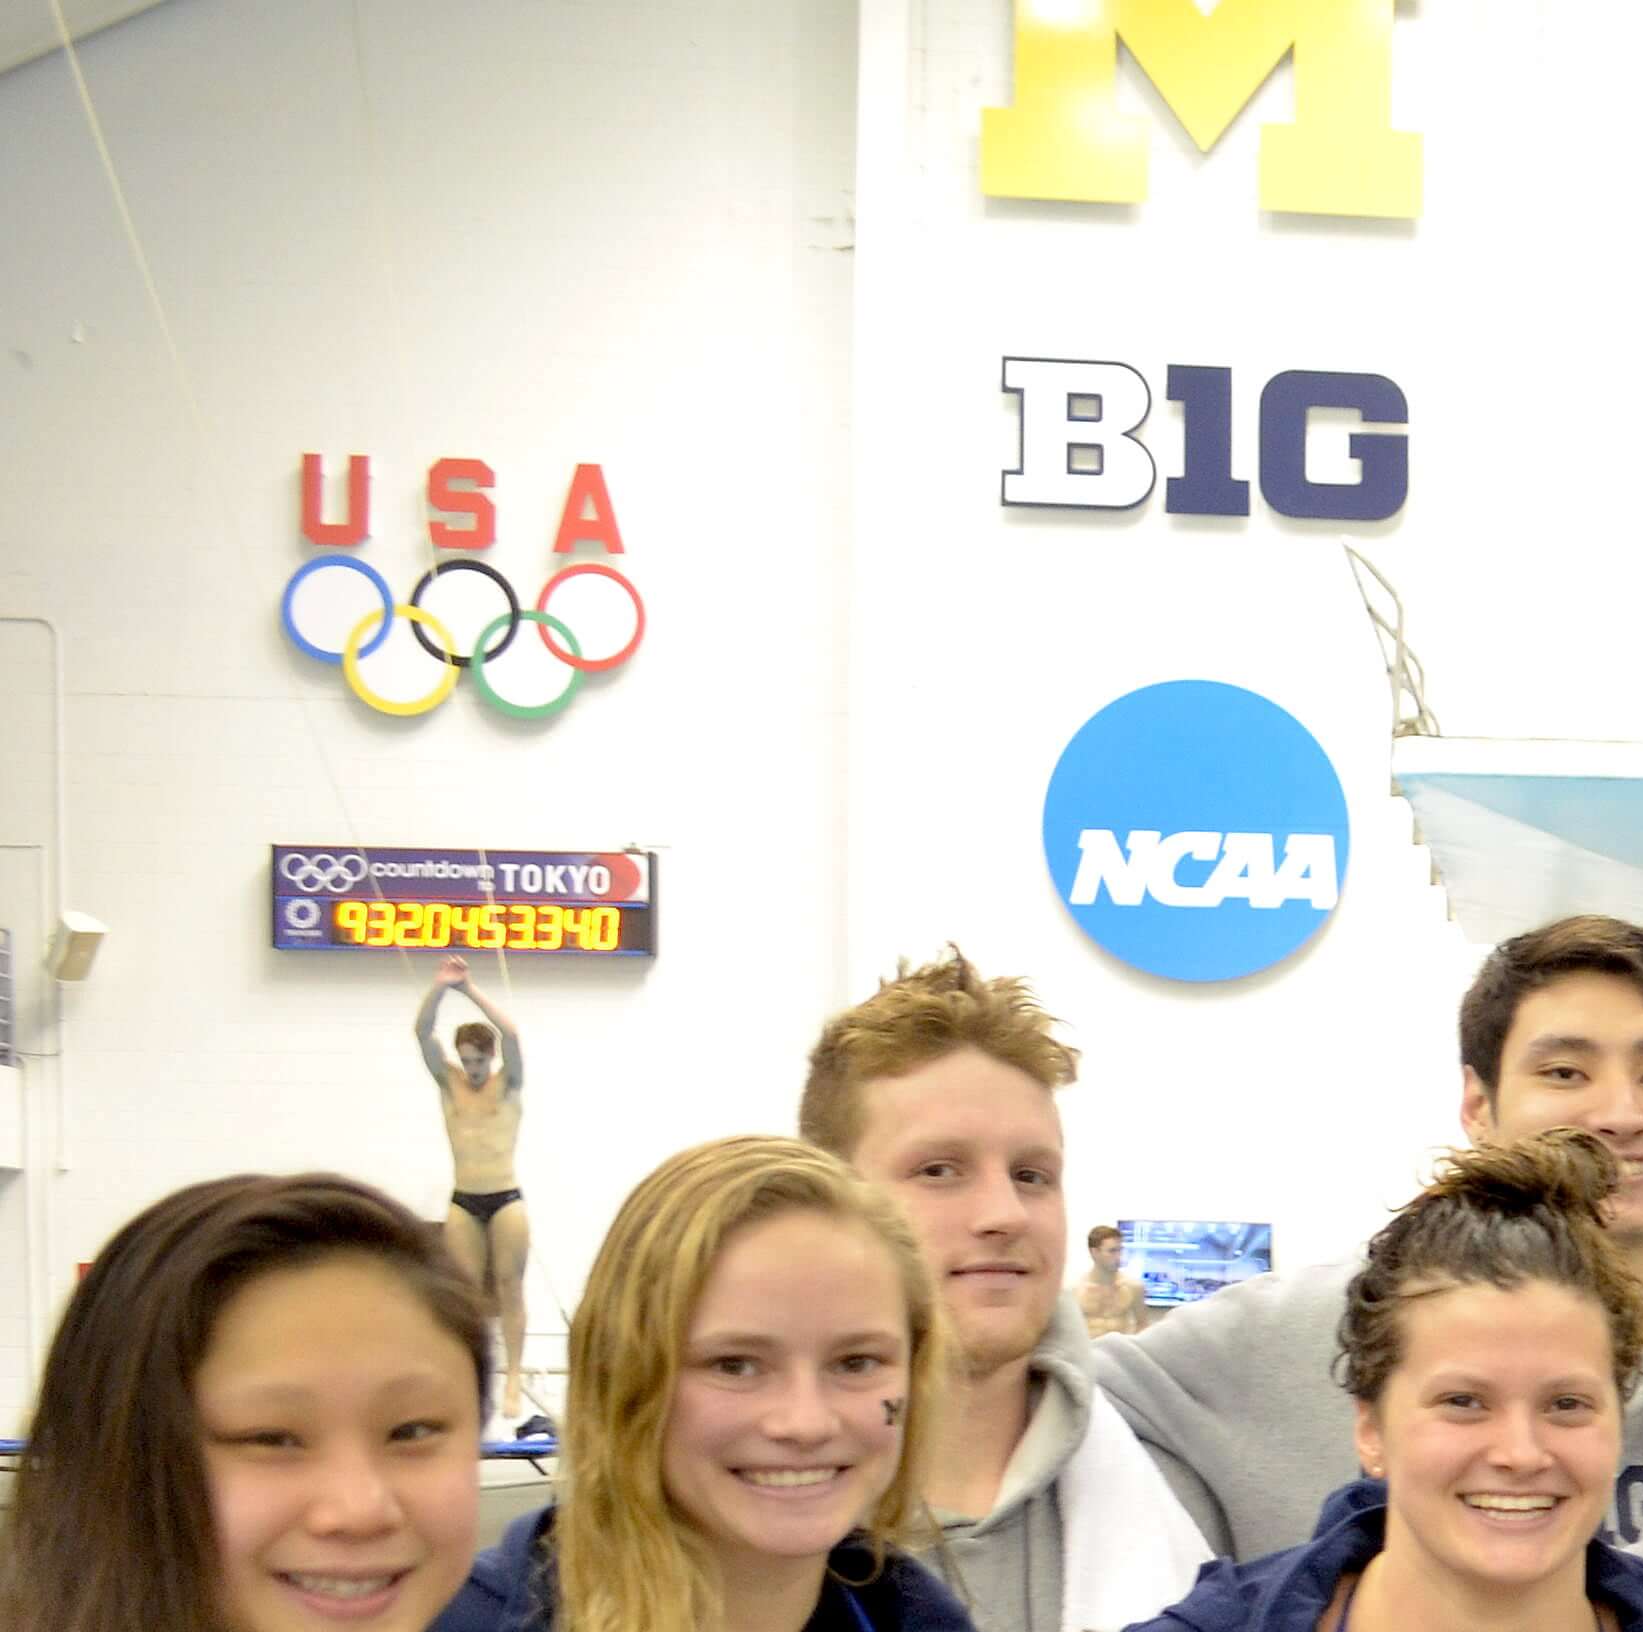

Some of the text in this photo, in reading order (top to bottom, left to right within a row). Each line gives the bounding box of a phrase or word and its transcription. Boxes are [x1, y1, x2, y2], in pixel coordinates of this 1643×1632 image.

[980, 0, 1424, 219] M
[500, 863, 610, 894] TOKYO
[1068, 829, 1339, 910] NCAA
